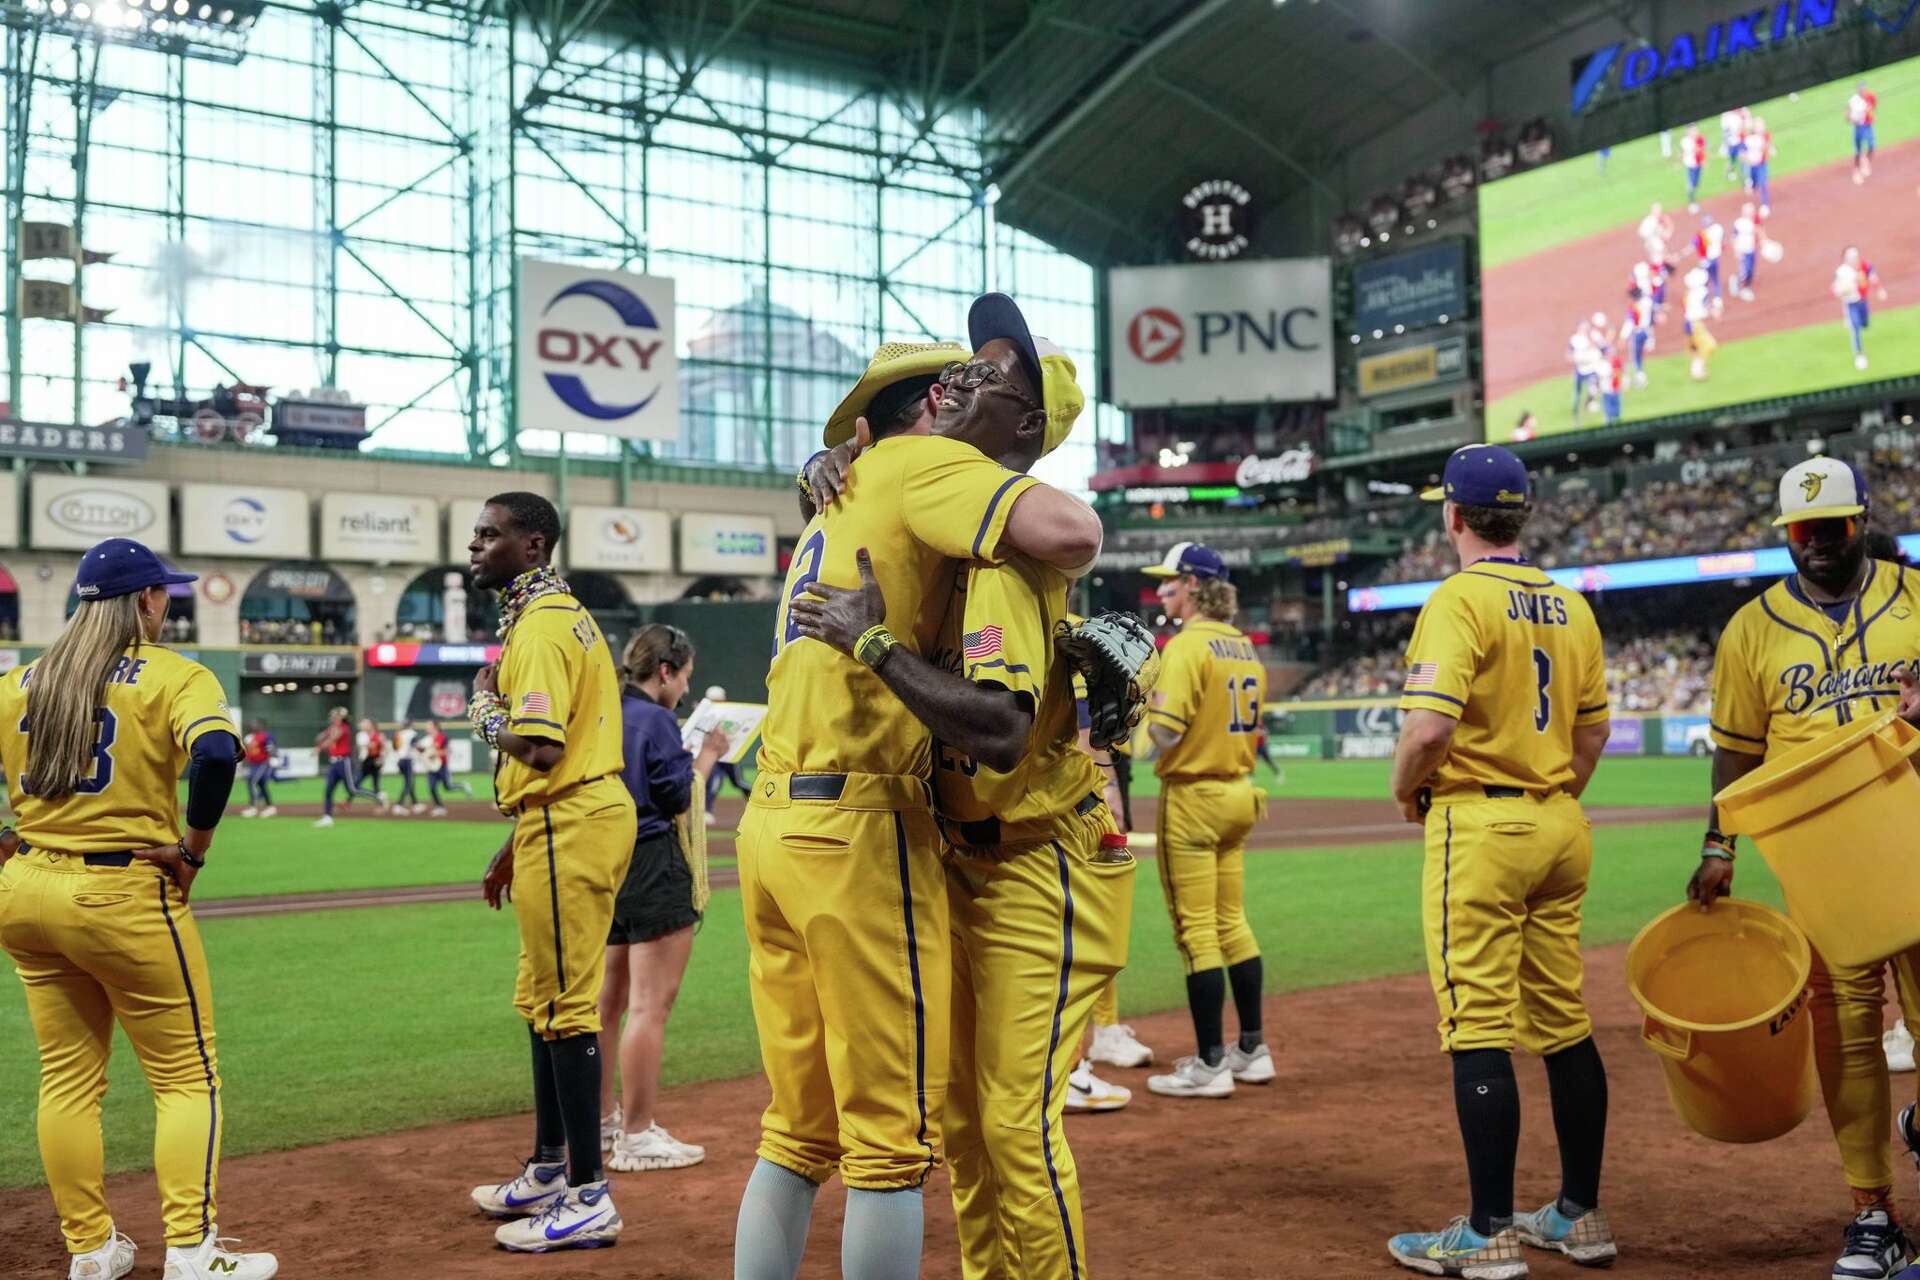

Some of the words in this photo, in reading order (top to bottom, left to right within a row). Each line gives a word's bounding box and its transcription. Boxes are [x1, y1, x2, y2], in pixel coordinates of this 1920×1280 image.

[1619, 0, 1836, 90] DAIKIN
[1202, 204, 1234, 235] H
[537, 329, 664, 371] OXY
[1194, 306, 1320, 355] PNC
[0, 424, 125, 452] EADERS
[339, 511, 412, 534] reliant
[1228, 675, 1259, 733] 13
[1532, 647, 1552, 735] 3
